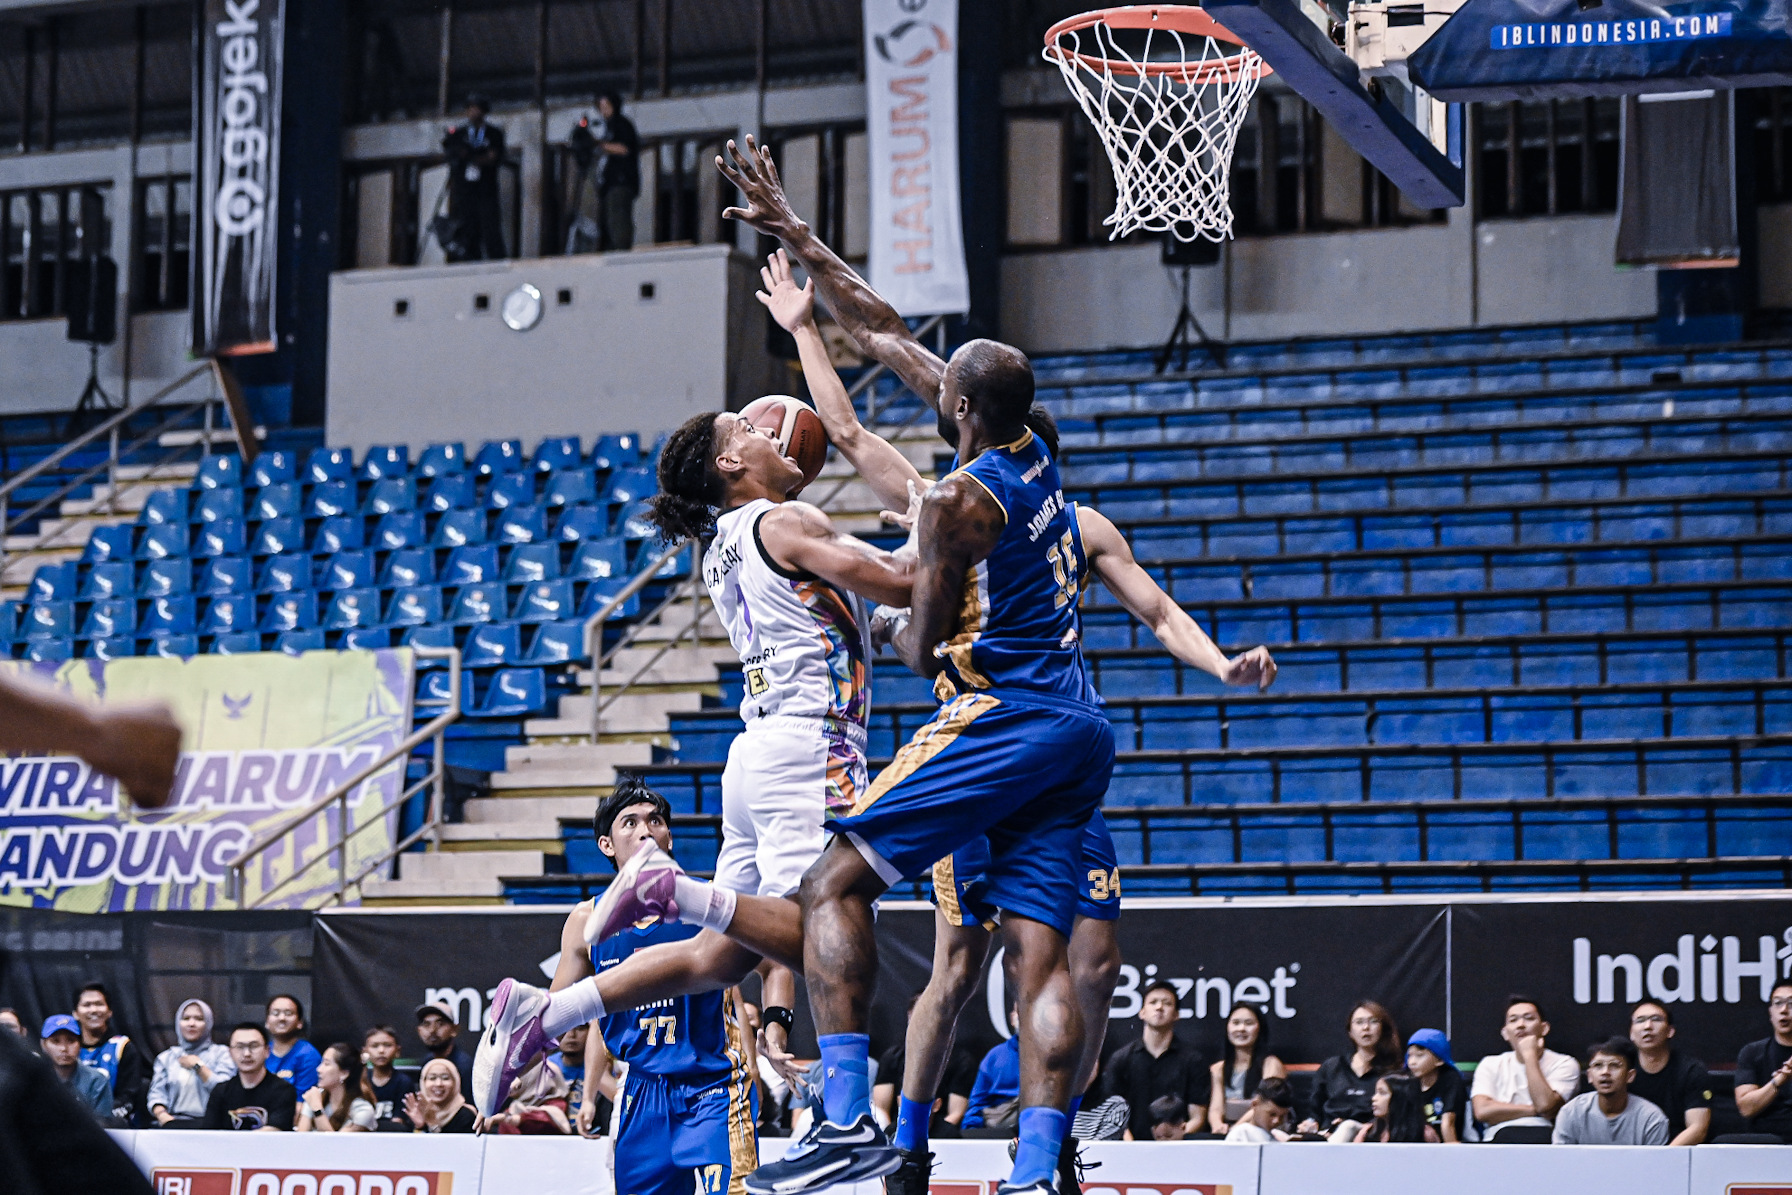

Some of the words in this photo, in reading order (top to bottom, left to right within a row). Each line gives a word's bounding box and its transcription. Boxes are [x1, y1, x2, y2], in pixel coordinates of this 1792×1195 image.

[1501, 15, 1719, 46] IBLINDONESIA.COM
[215, 0, 269, 168] gojek
[889, 76, 933, 275] HARUM
[1027, 495, 1058, 542] JAMES
[1087, 866, 1121, 900] 34
[639, 1015, 677, 1046] 77
